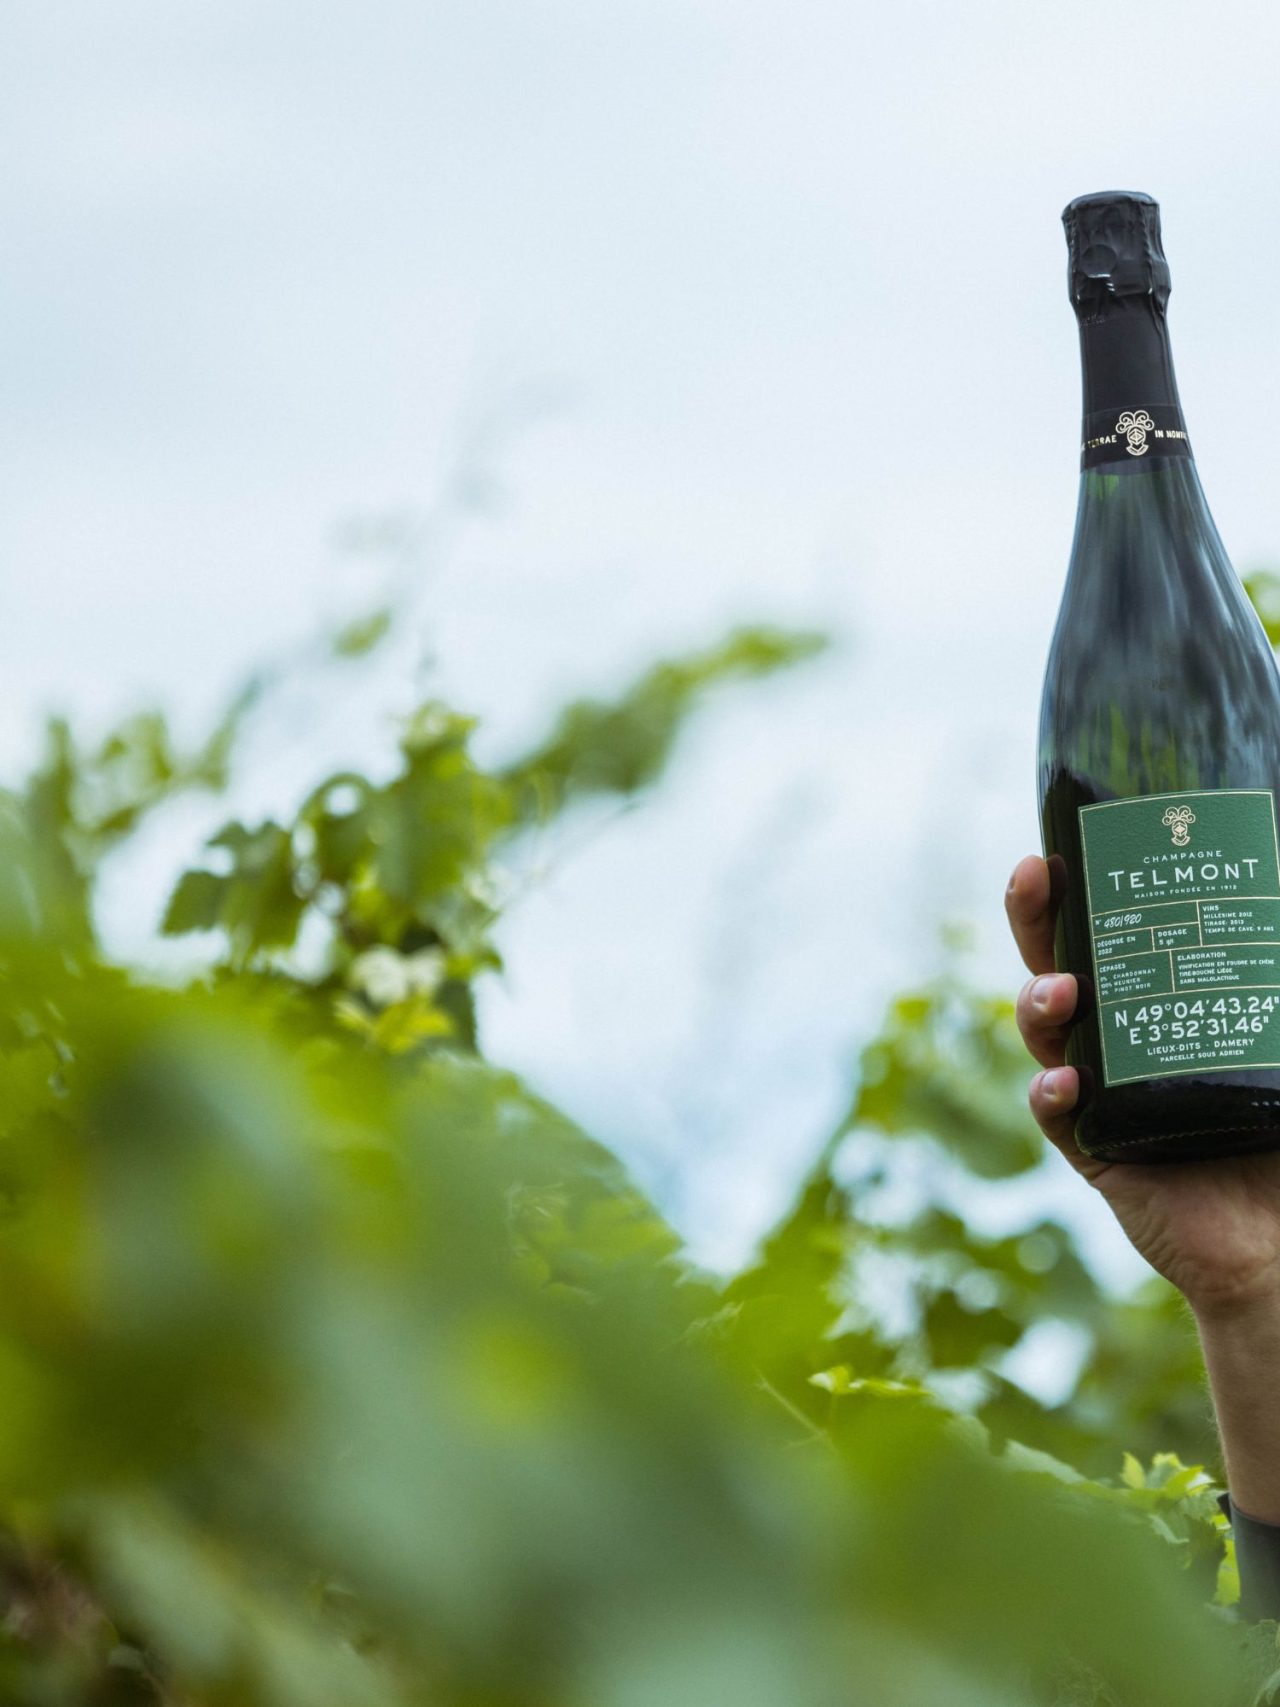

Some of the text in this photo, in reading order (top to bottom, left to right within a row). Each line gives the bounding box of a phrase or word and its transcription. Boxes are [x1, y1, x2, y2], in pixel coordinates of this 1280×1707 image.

[1154, 430, 1164, 438] IN
[1143, 850, 1222, 864] CHAMPAGNE
[1108, 859, 1258, 891] TELMONT
[1134, 890, 1165, 898] MAISON
[1170, 885, 1201, 895] FONDÉE
[1157, 929, 1187, 937] DOSAGE
[1098, 948, 1113, 956] 2022
[1099, 963, 1126, 973] CÉPAGES
[1178, 962, 1215, 970] VINIFICATION
[1113, 968, 1156, 980] CHARDONNAY
[1197, 974, 1240, 983] MALOLACTIQUE
[1113, 977, 1141, 986] MEUNIER
[1136, 982, 1151, 990] NOIR
[1115, 1010, 1128, 1028] N
[1130, 1027, 1142, 1045] E
[1147, 1042, 1200, 1056] LIEUX-DITS
[1214, 1038, 1255, 1048] DAMERY
[1160, 1049, 1244, 1063] PARCELLE SOUS ADRIEN
